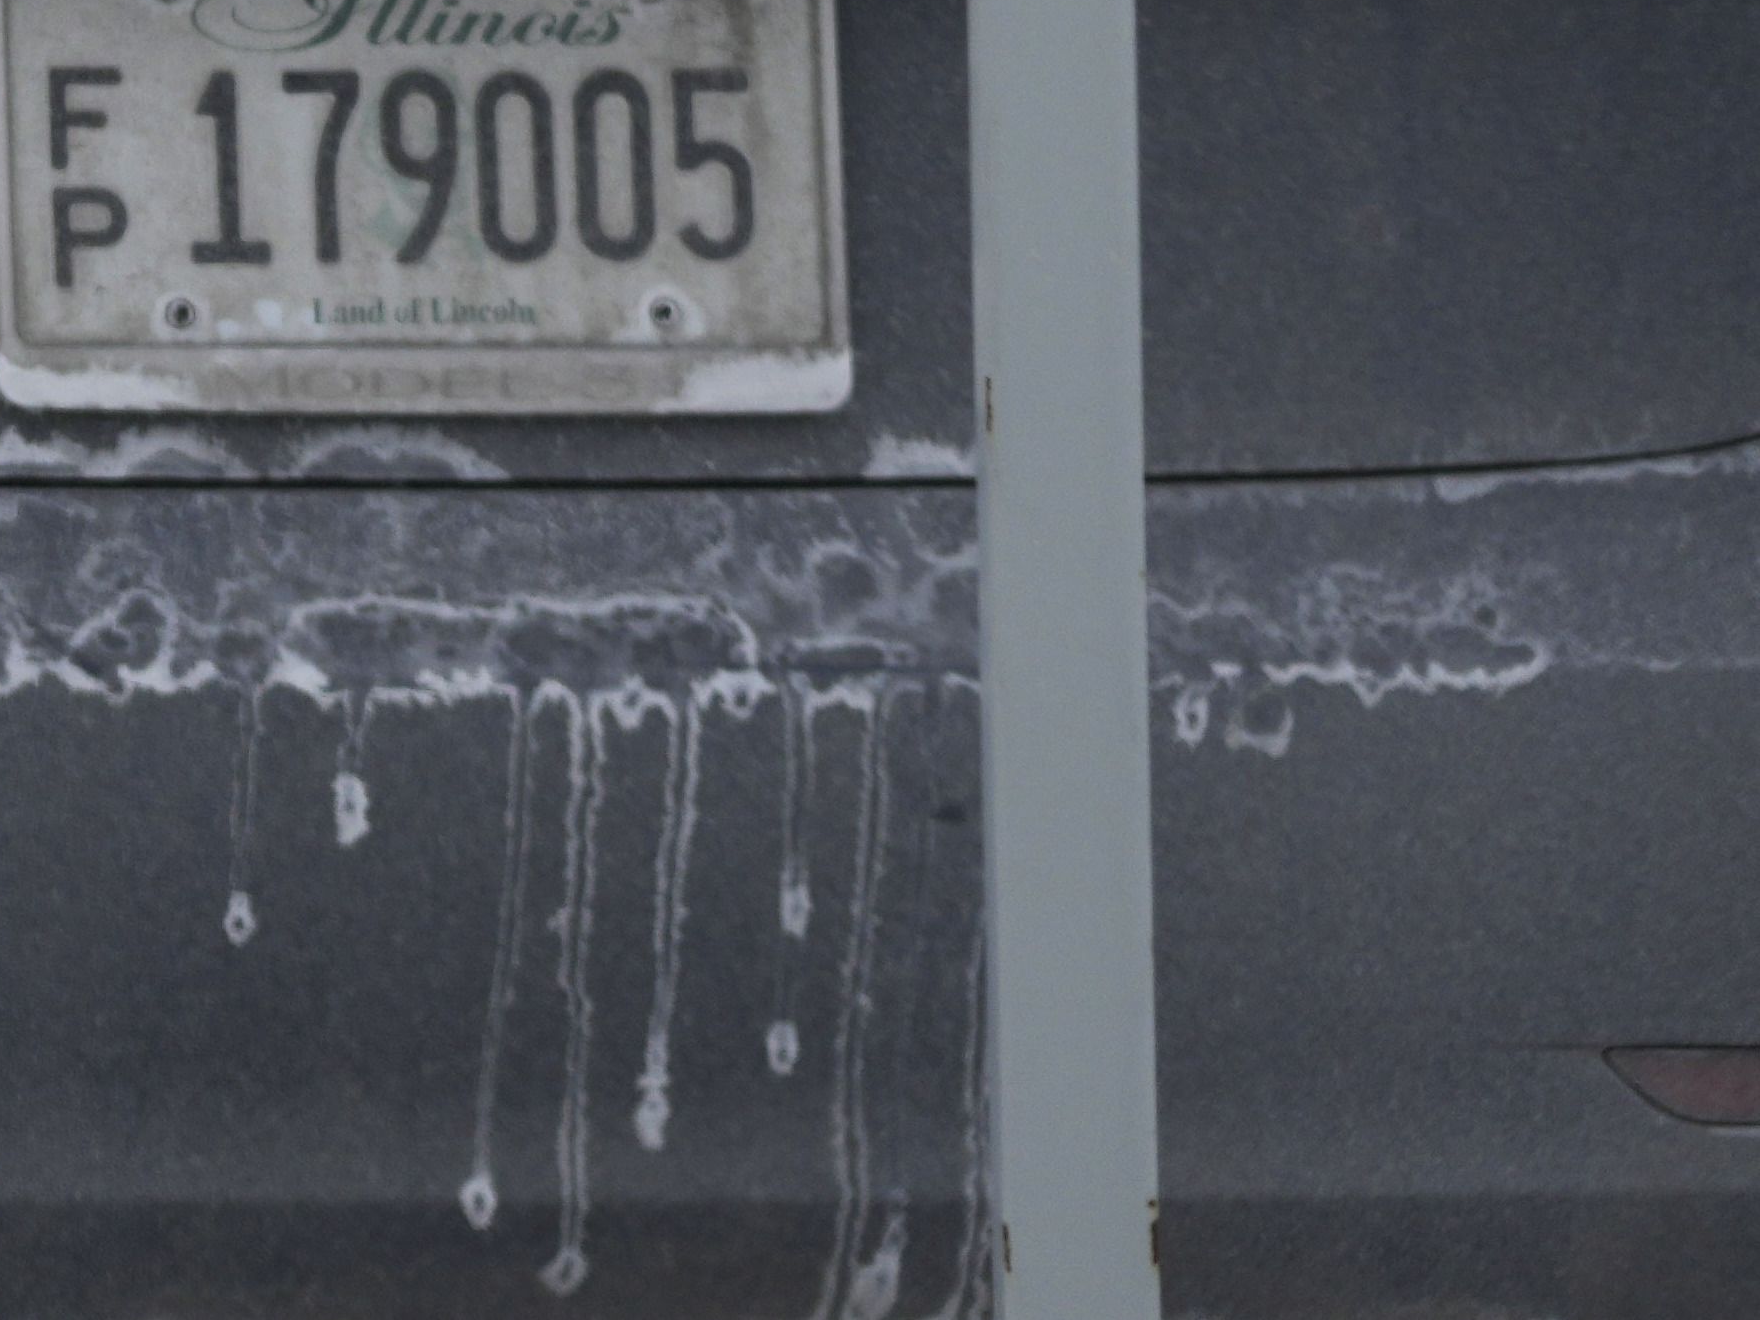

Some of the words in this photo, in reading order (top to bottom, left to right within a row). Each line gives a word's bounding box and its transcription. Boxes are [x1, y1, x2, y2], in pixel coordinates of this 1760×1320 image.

[190, 67, 755, 265] 179005
[313, 297, 384, 324] Land
[394, 297, 421, 324] of
